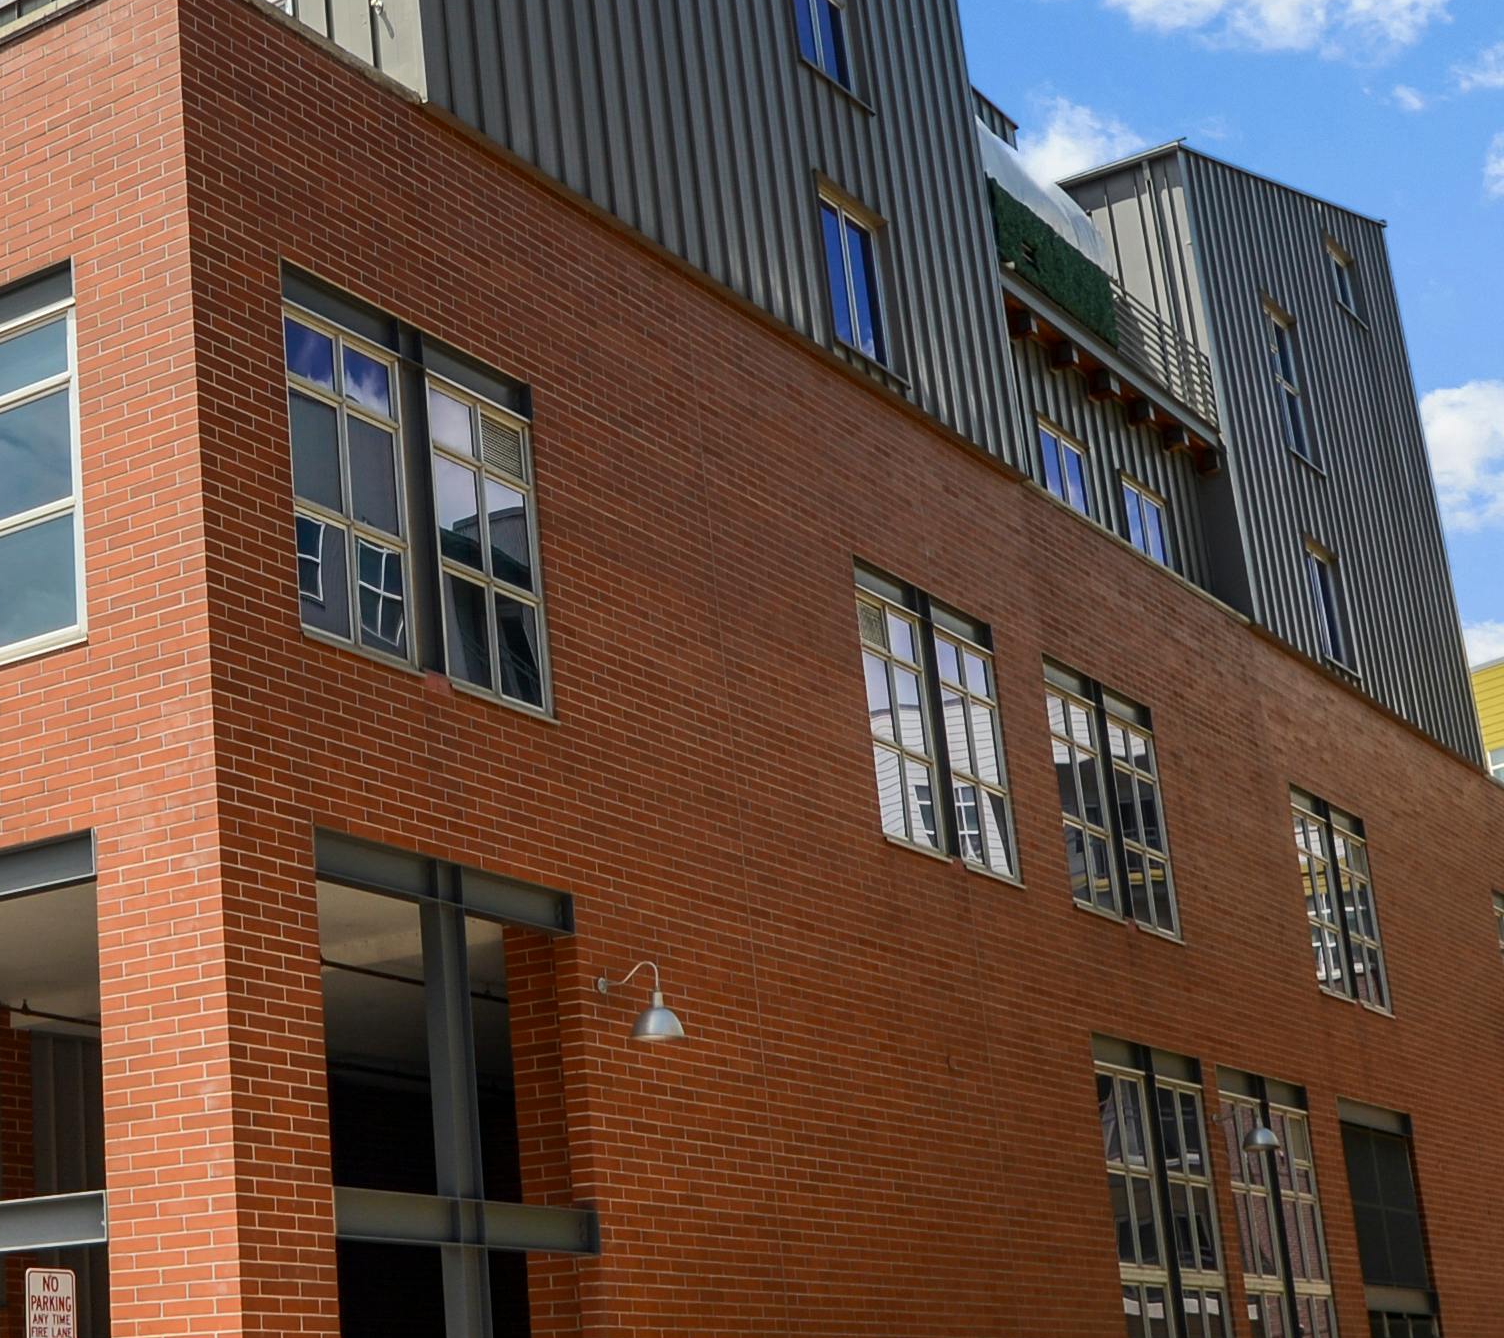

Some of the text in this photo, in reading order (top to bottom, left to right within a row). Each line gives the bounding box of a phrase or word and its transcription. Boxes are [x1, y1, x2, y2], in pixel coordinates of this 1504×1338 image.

[42, 1276, 59, 1292] NO
[31, 1295, 72, 1312] PARKING
[32, 1313, 71, 1325] ANY TIME
[32, 1326, 72, 1338] FIRE LANE
